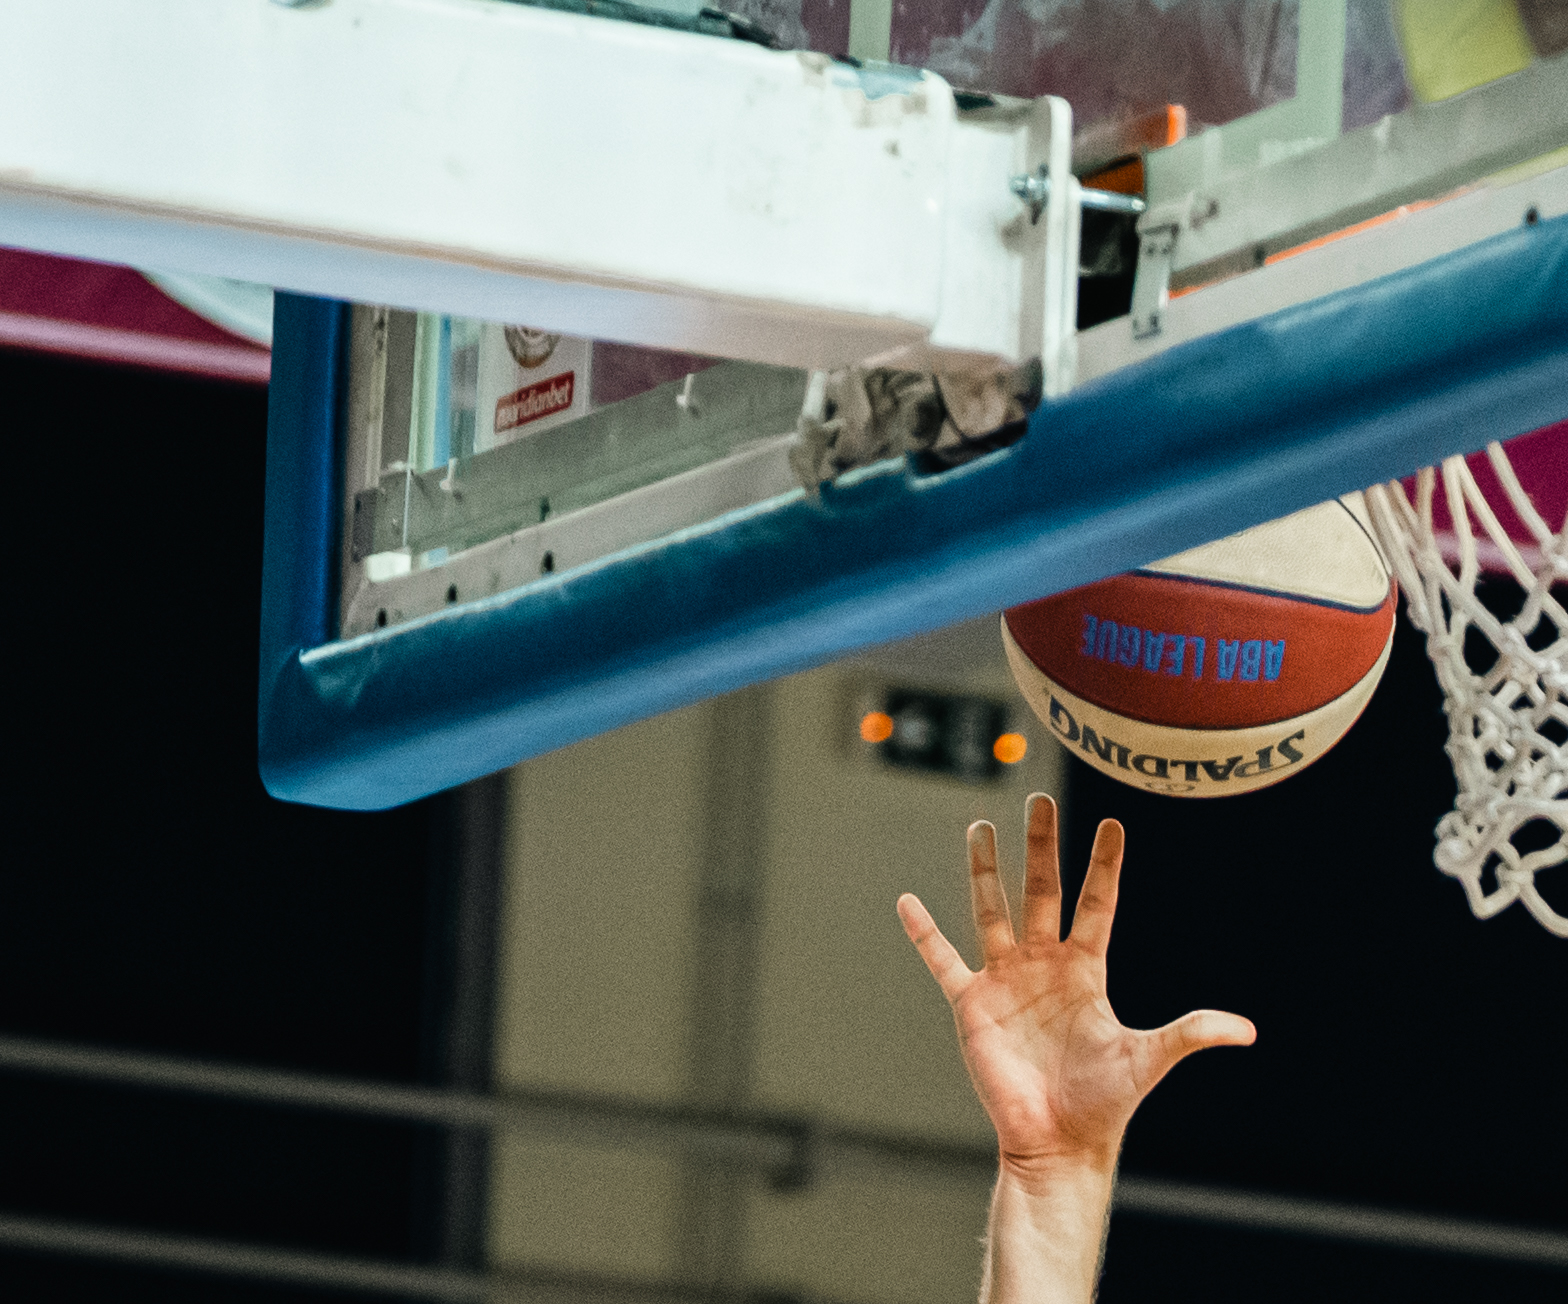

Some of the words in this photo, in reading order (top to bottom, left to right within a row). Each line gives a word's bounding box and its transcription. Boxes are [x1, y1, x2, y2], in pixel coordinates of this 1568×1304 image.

[1081, 614, 1206, 680] LEAGUE
[1217, 638, 1287, 682] ABA
[1048, 694, 1307, 784] SPALDING
